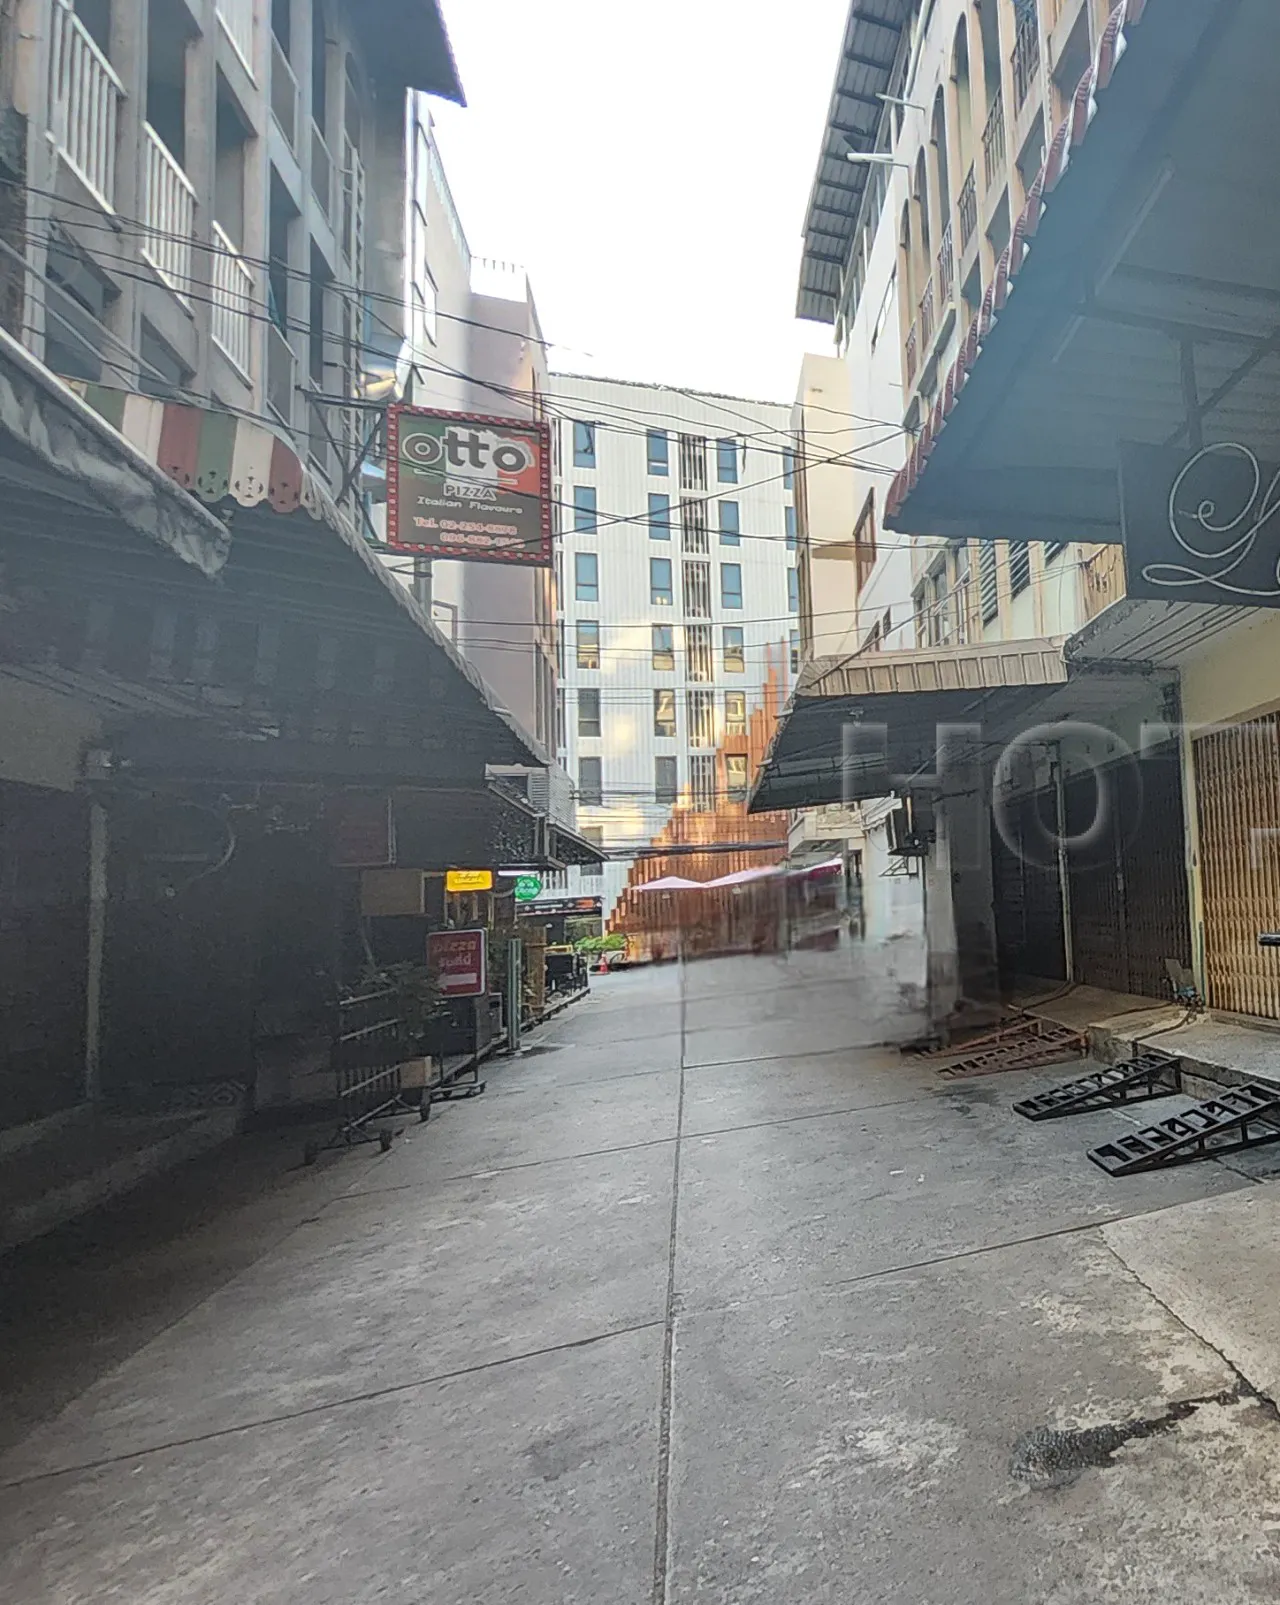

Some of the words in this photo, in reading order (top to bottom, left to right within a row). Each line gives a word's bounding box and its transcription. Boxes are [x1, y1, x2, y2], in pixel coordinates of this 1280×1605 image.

[402, 427, 527, 475] otto
[443, 482, 497, 501] PIZZA
[417, 496, 462, 509] Italian
